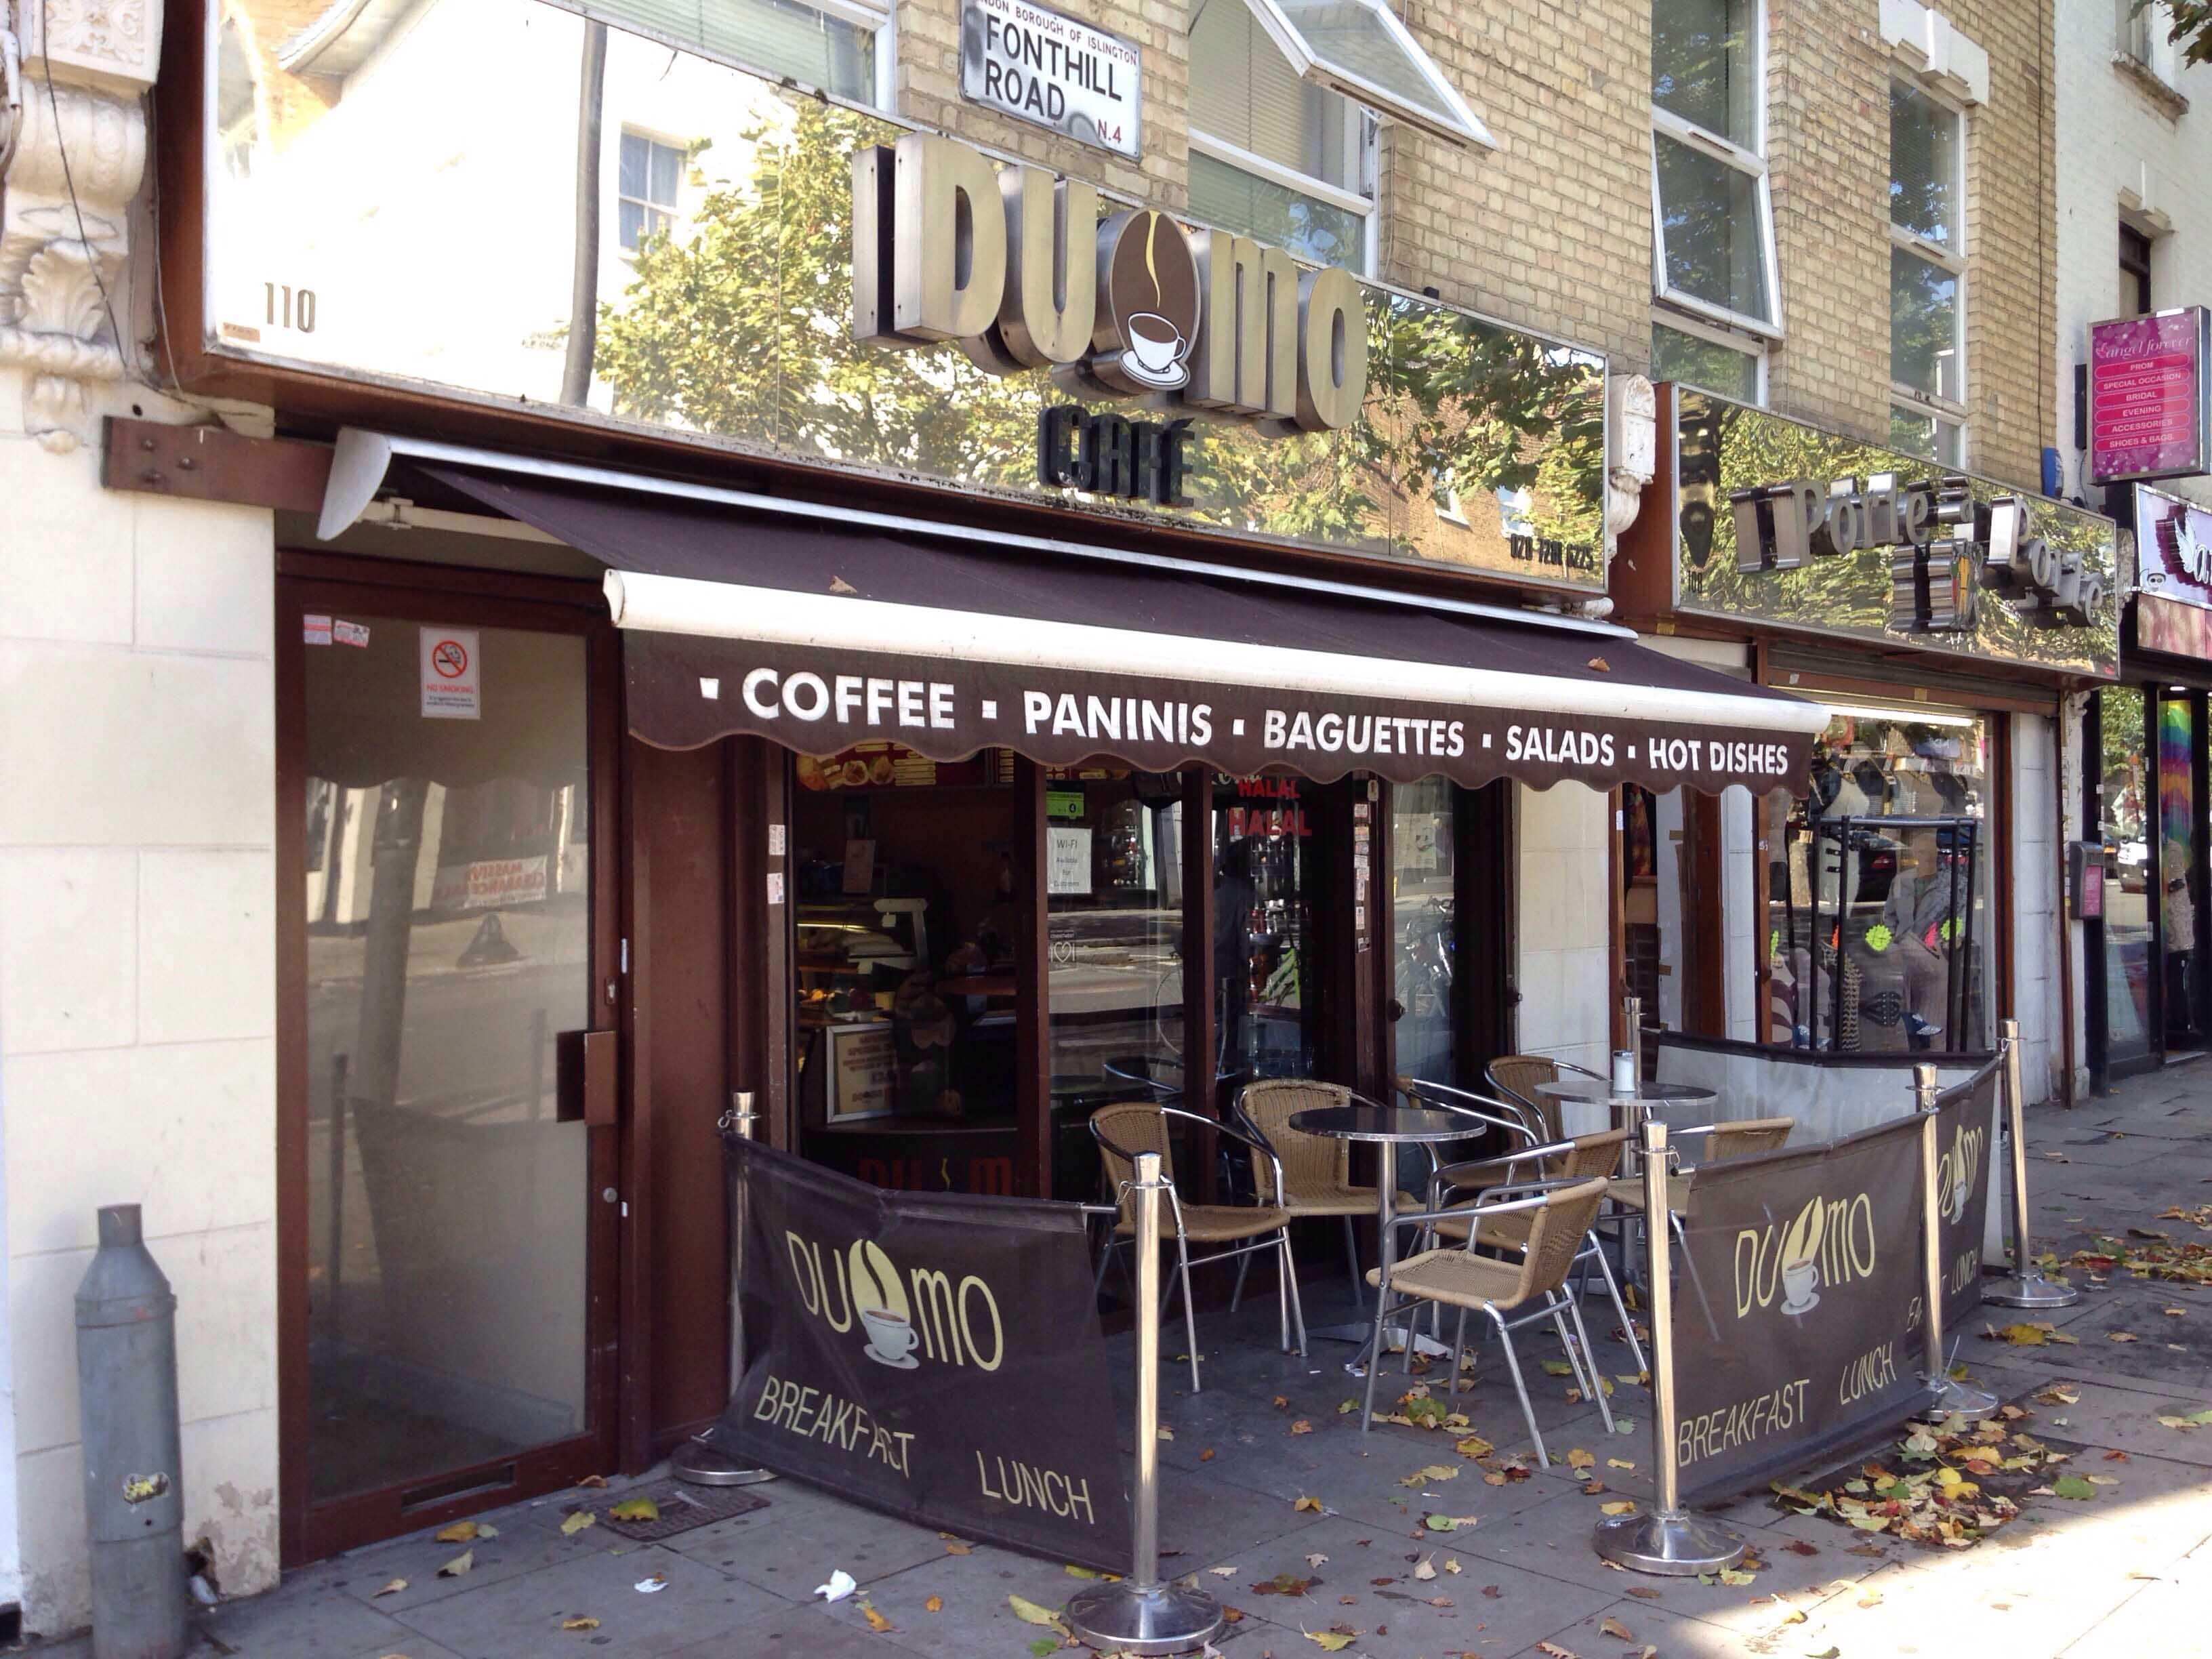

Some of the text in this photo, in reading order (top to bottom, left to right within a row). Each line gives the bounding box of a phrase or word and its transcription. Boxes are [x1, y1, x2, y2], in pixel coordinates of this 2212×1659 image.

[1016, 6, 1064, 36] BOROUGH
[1070, 28, 1082, 43] OF
[1088, 37, 1137, 66] ISLINGTON
[986, 14, 1122, 102] FONTHILL
[985, 58, 1065, 121] ROAD
[1097, 119, 1122, 144] N.4
[265, 282, 316, 333] 110
[2130, 362, 2154, 371] PROM
[2103, 372, 2182, 390] SPECIAL OCCASION
[2126, 390, 2157, 402] BRIDAL
[2123, 405, 2161, 417] EVENING
[2112, 418, 2173, 433] ACCESSORIES
[2110, 438, 2139, 448] SHOES
[2149, 433, 2173, 444] BAGS
[1687, 569, 1703, 594] 108
[742, 667, 1788, 775] COFFEE PANINIS BAGUETTES SALADS HOT DISHES
[1237, 779, 1302, 798] HALAL
[1228, 808, 1313, 836] HALAL
[1839, 1341, 1897, 1406] LUNCH
[1677, 1378, 1810, 1467] BREAKFAST
[976, 1450, 1095, 1525] LUNCH
